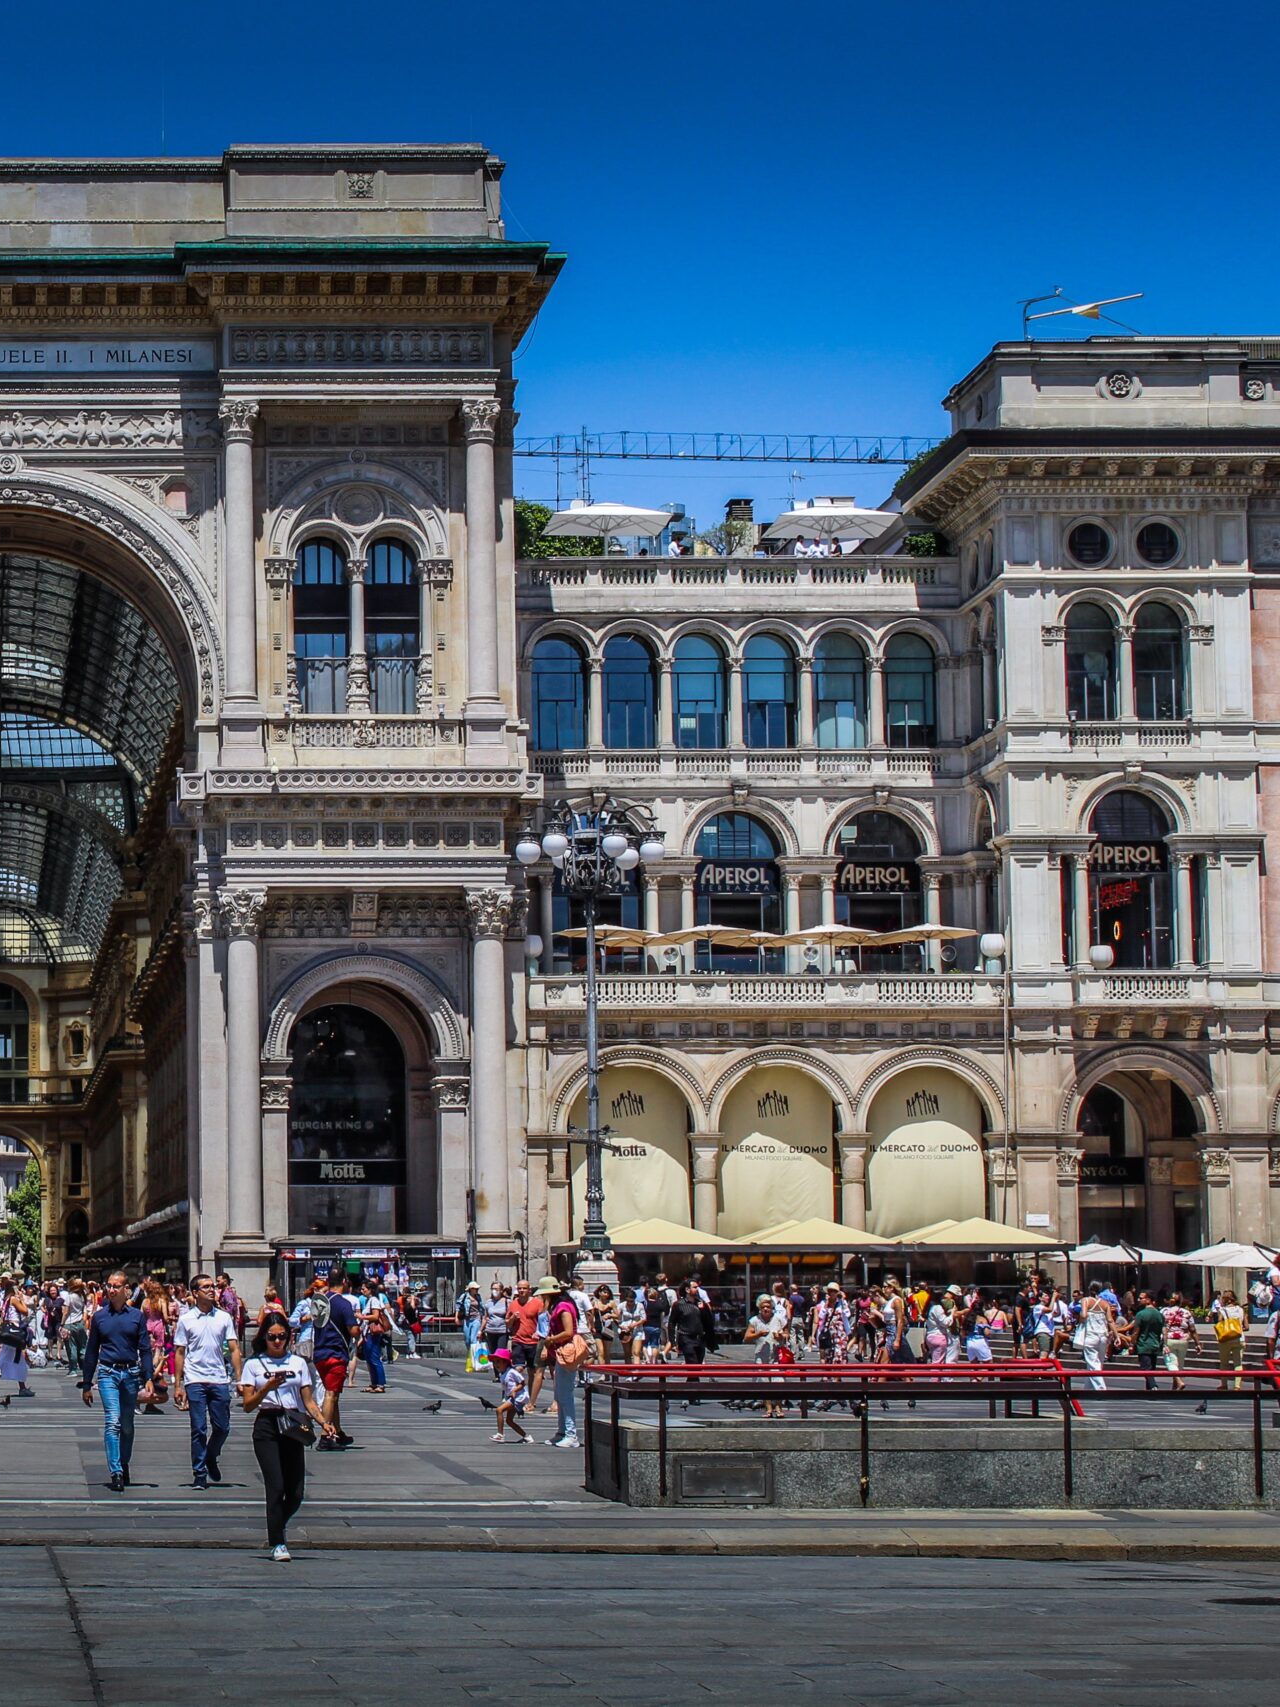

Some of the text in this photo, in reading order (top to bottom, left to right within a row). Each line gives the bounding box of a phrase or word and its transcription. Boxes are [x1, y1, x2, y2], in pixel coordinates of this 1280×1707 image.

[105, 349, 193, 363] MILANESI
[1088, 842, 1161, 864] APEROL
[700, 863, 770, 885] APEROL
[840, 863, 910, 885] APEROL
[700, 884, 770, 892] TERRAZZA
[840, 884, 910, 892] TERRAZZA
[291, 1120, 362, 1130] BURGER KING
[611, 1144, 647, 1157] Motta
[731, 1144, 775, 1154] MERCATO
[789, 1145, 828, 1154] DUOMO
[869, 1144, 877, 1152] IL
[879, 1144, 926, 1153] MERCATO
[940, 1144, 979, 1153] DUOMO
[319, 1163, 366, 1179] Motta
